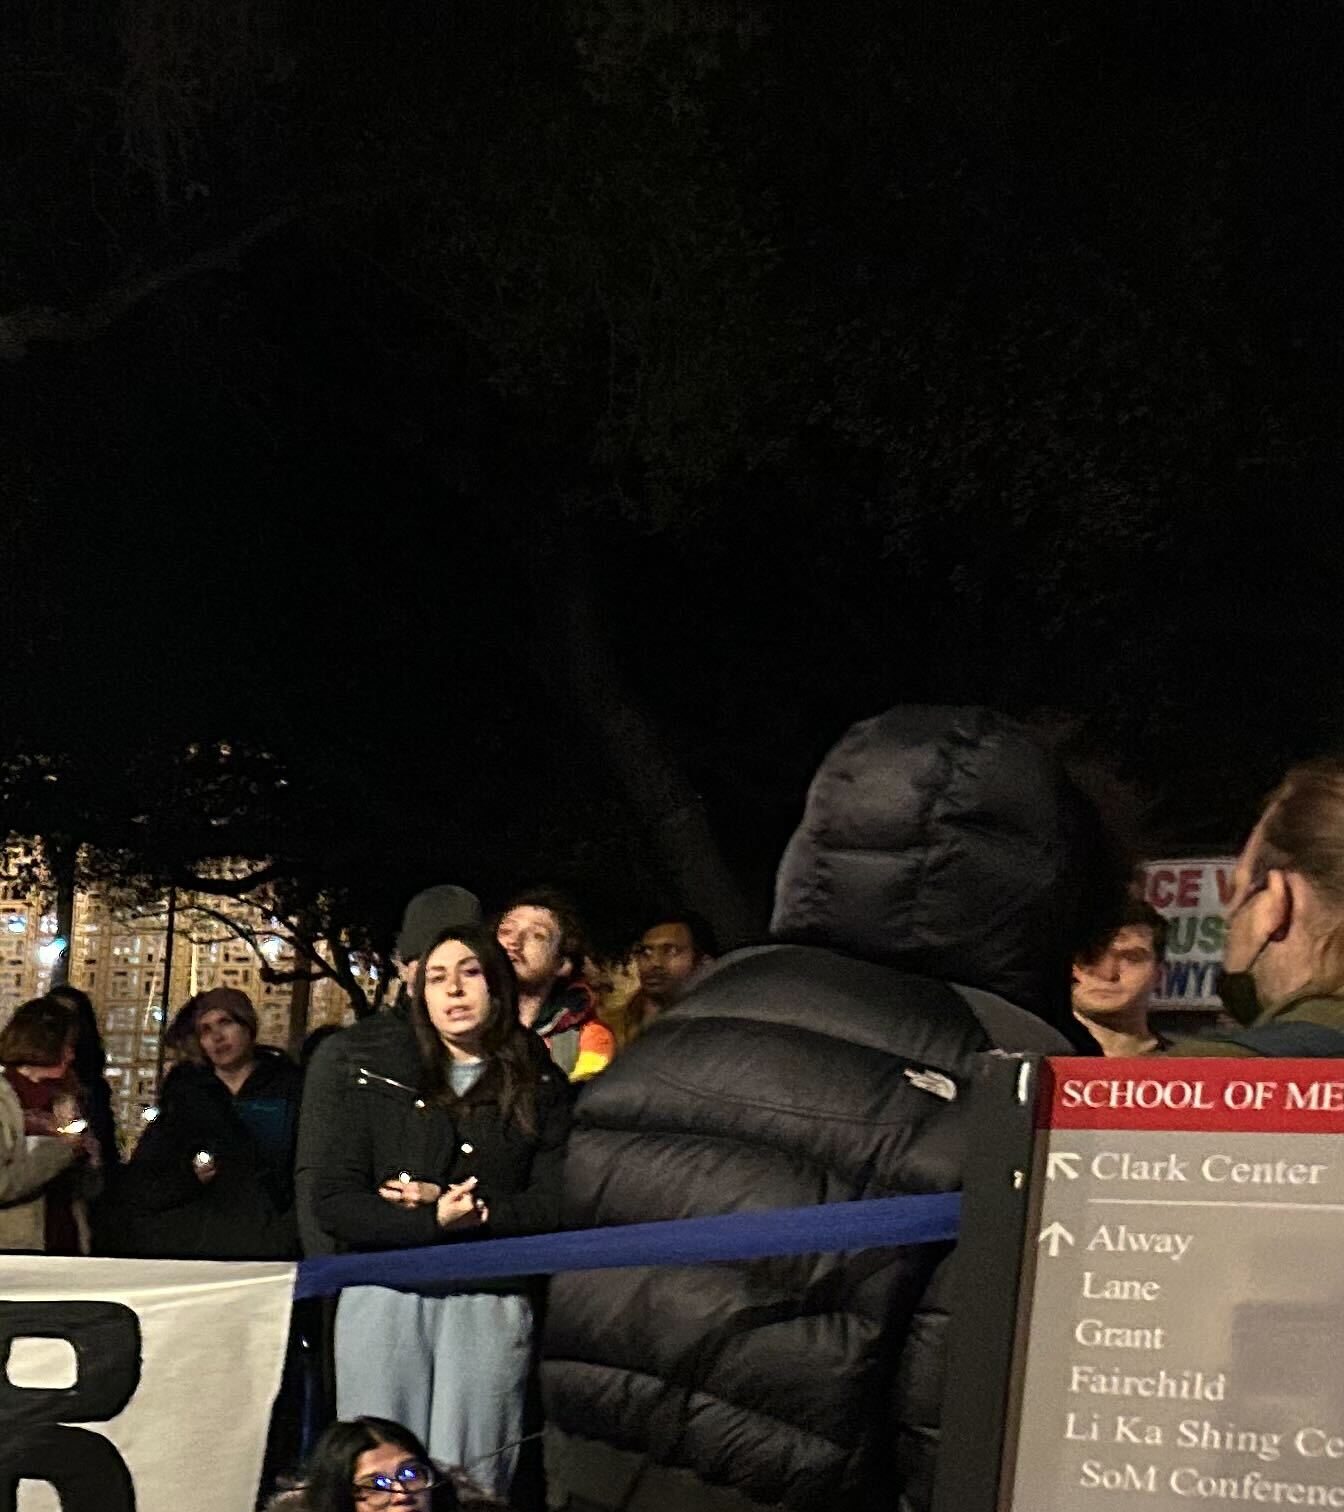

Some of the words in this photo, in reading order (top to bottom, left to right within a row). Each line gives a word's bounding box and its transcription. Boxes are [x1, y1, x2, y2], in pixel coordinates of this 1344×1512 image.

[1061, 1079, 1214, 1110] SCHOOL
[1223, 1080, 1278, 1111] OF
[1090, 1151, 1189, 1183] Clark
[1201, 1154, 1328, 1185] Center
[1086, 1224, 1193, 1263] Alway
[1081, 1272, 1161, 1301] Lane
[1074, 1320, 1166, 1350] Grant
[1068, 1366, 1227, 1402] Fairchild
[1063, 1413, 1100, 1441] Li
[1115, 1416, 1164, 1445] Ka
[1176, 1419, 1280, 1461] Shing
[1079, 1460, 1157, 1493] SoM
